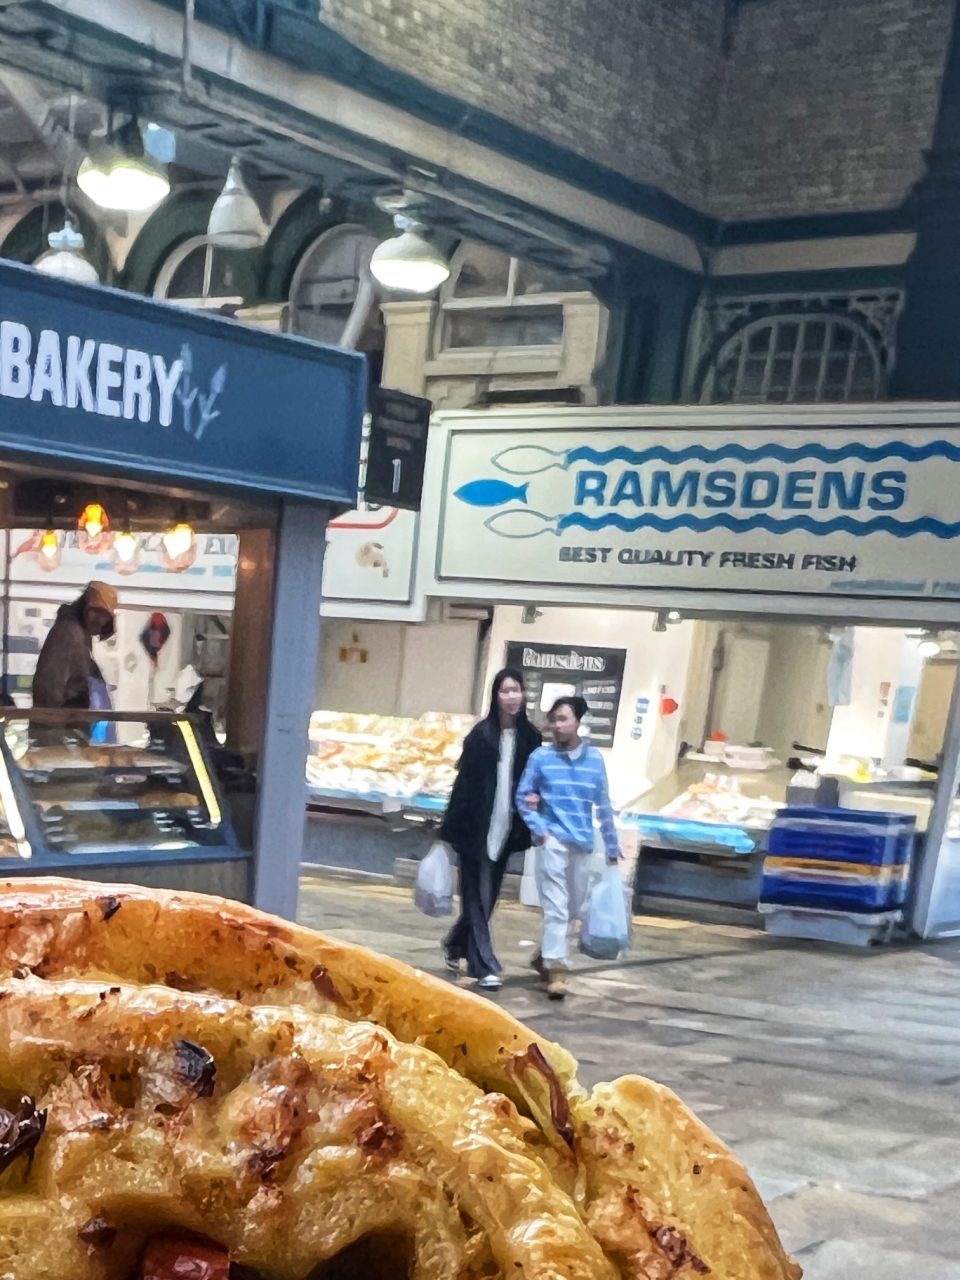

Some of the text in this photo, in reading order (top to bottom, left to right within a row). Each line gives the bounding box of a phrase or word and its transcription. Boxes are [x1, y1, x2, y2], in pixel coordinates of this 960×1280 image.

[574, 470, 907, 511] RAMSDENS
[559, 546, 857, 572] BEST QUALITY FRESH FISH
